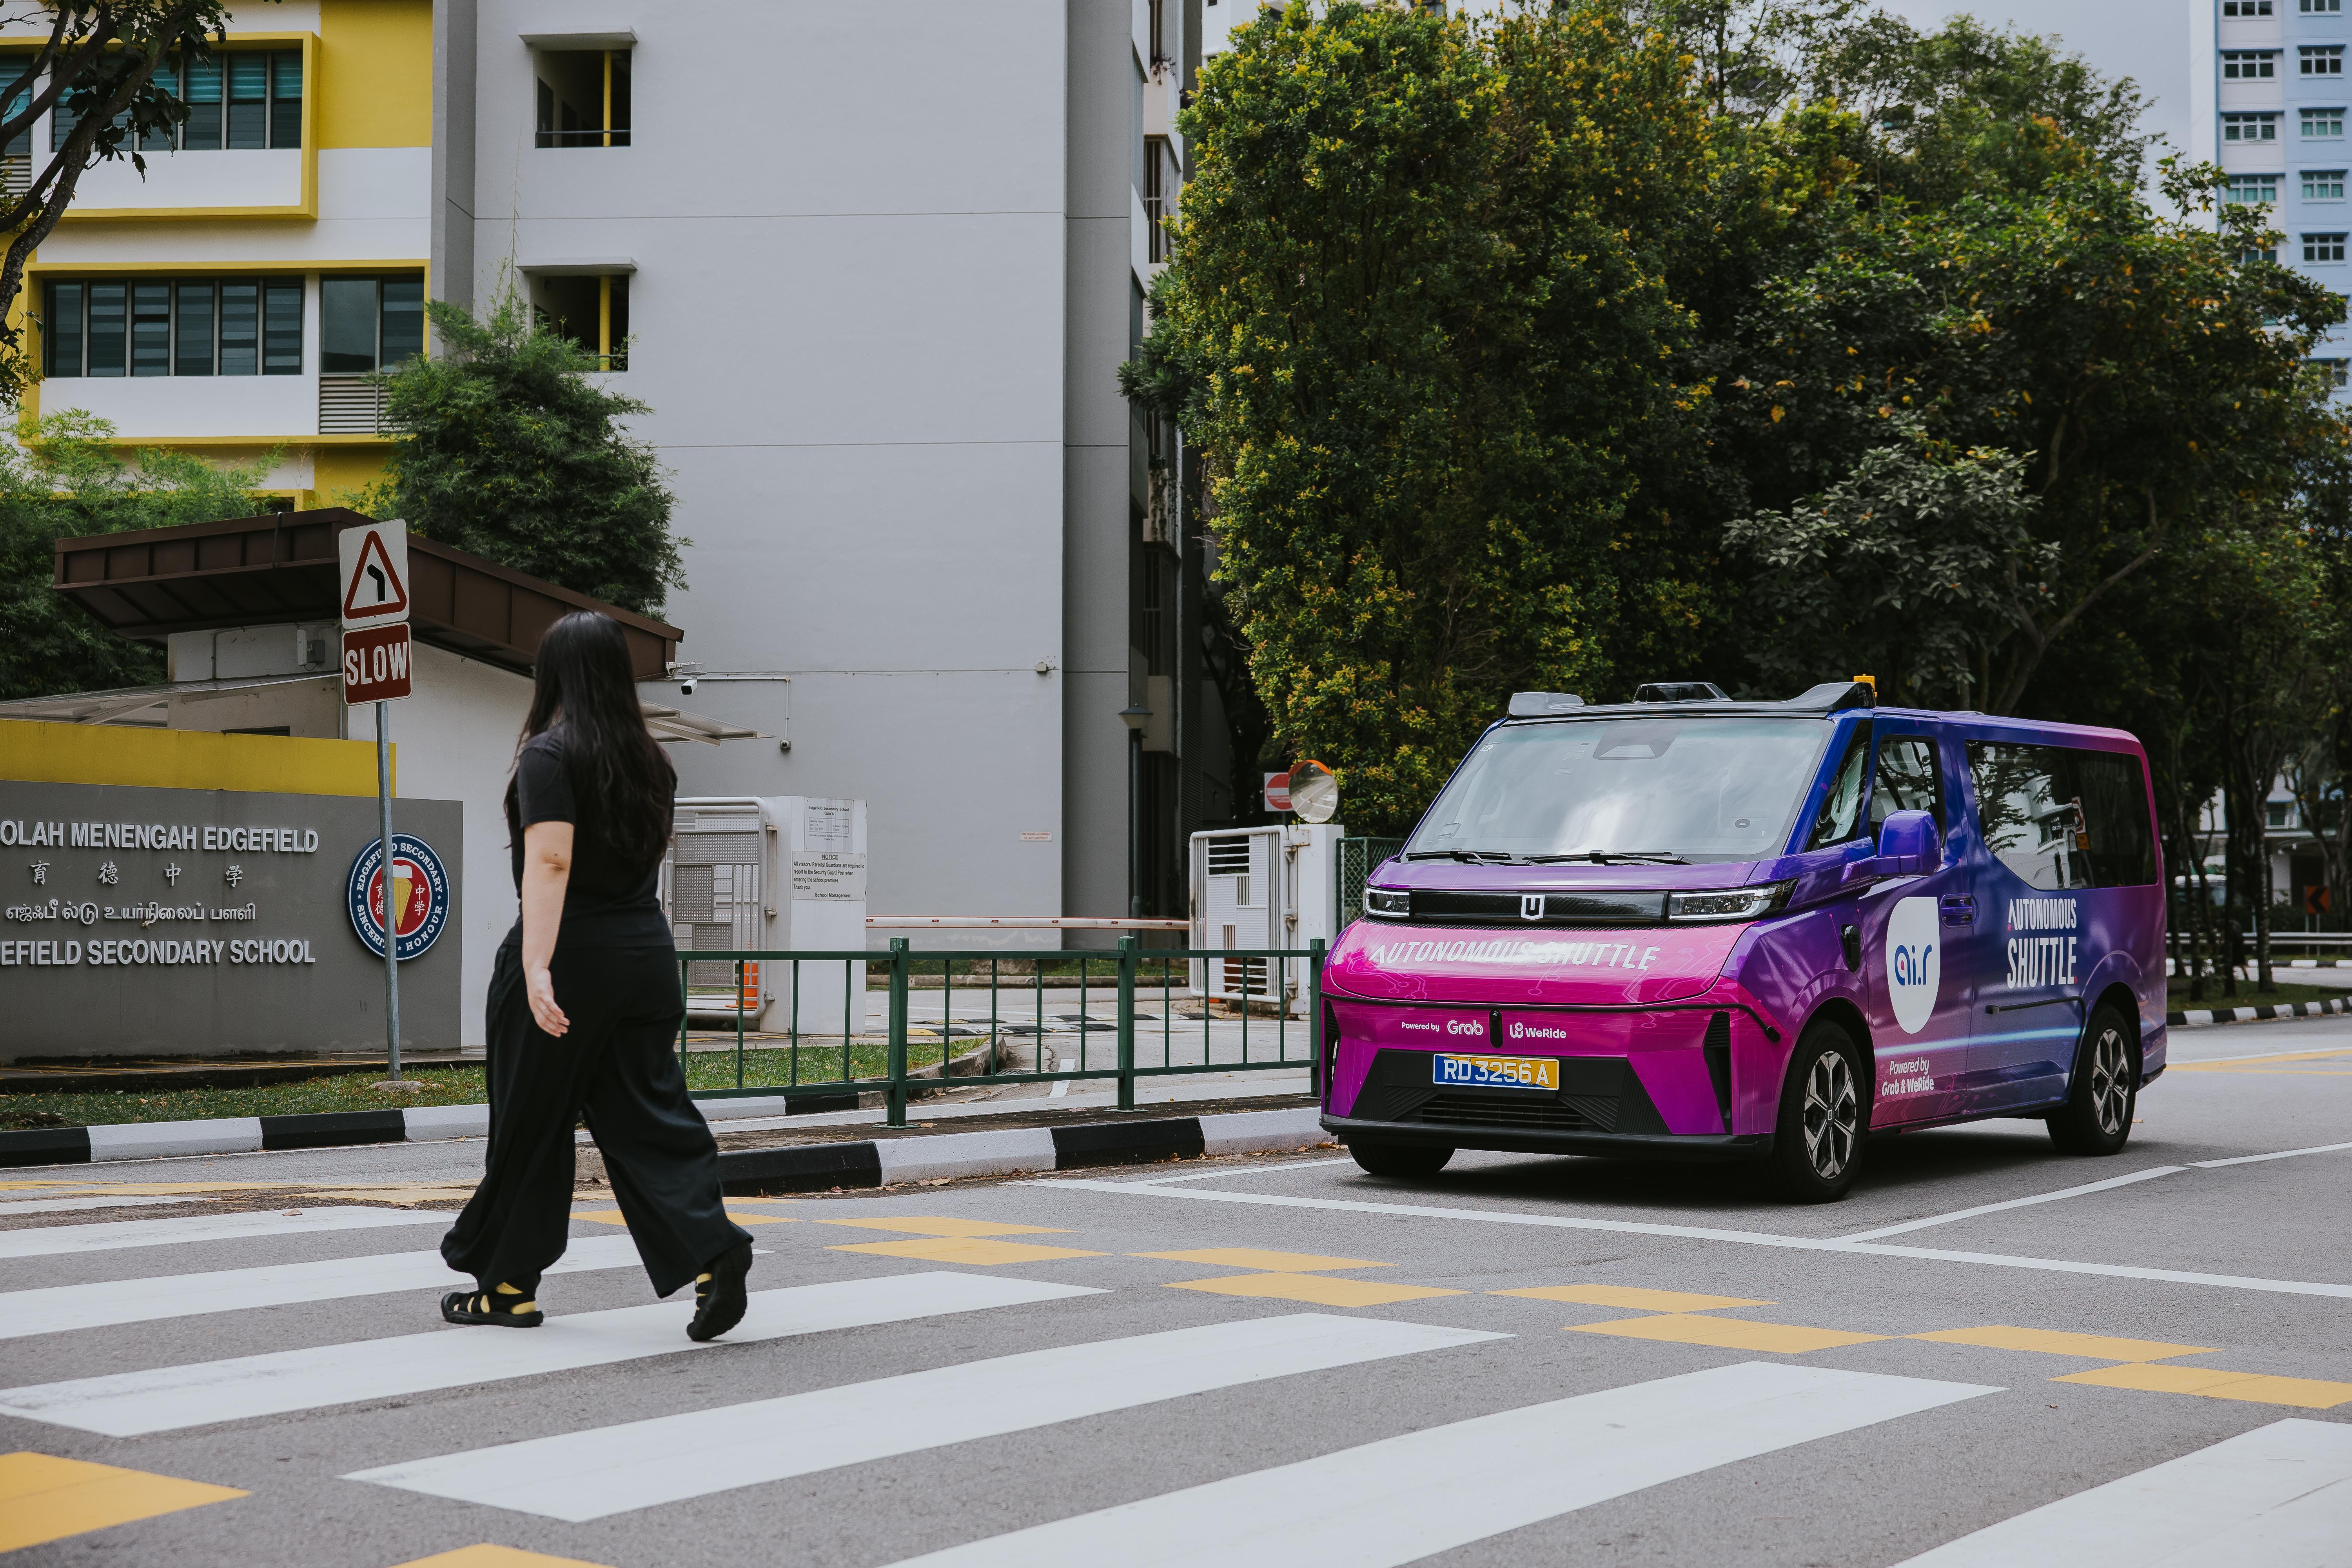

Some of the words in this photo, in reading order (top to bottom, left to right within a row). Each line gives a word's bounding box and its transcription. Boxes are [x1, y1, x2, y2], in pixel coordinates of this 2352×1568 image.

[346, 642, 407, 686] SLOW
[0, 820, 64, 846] OLAH
[70, 822, 197, 850] MENENGAH
[203, 826, 319, 853] EDGEFIELD
[29, 859, 243, 887] 育德中学
[357, 843, 397, 891] EDGEFID
[400, 842, 442, 893] SECONDARY
[414, 884, 425, 916] 中学
[2008, 898, 2076, 931] AUTONOMOUS
[357, 904, 385, 948] SINCERI
[406, 906, 443, 951] HONOUR
[0, 940, 81, 965] EFIELD
[87, 939, 225, 965] SECONDARY
[229, 939, 316, 964] SCHOOL
[1369, 940, 1530, 964] AUTONOMOUS
[1537, 942, 1661, 970] SHUTTLE
[1401, 1022, 1430, 1030] Powered
[1430, 1023, 1440, 1032] by
[1447, 1020, 1483, 1035] Grab
[1525, 1027, 1567, 1038] WeRide
[1444, 1059, 1471, 1080] RD
[1475, 1060, 1532, 1083] 3256
[1536, 1063, 1549, 1085] A
[1889, 1056, 1920, 1075] Powered
[1920, 1056, 1929, 1075] by
[1882, 1079, 1900, 1096] Grab
[1900, 1079, 1906, 1094] &
[1907, 1075, 1934, 1093] WeRide
